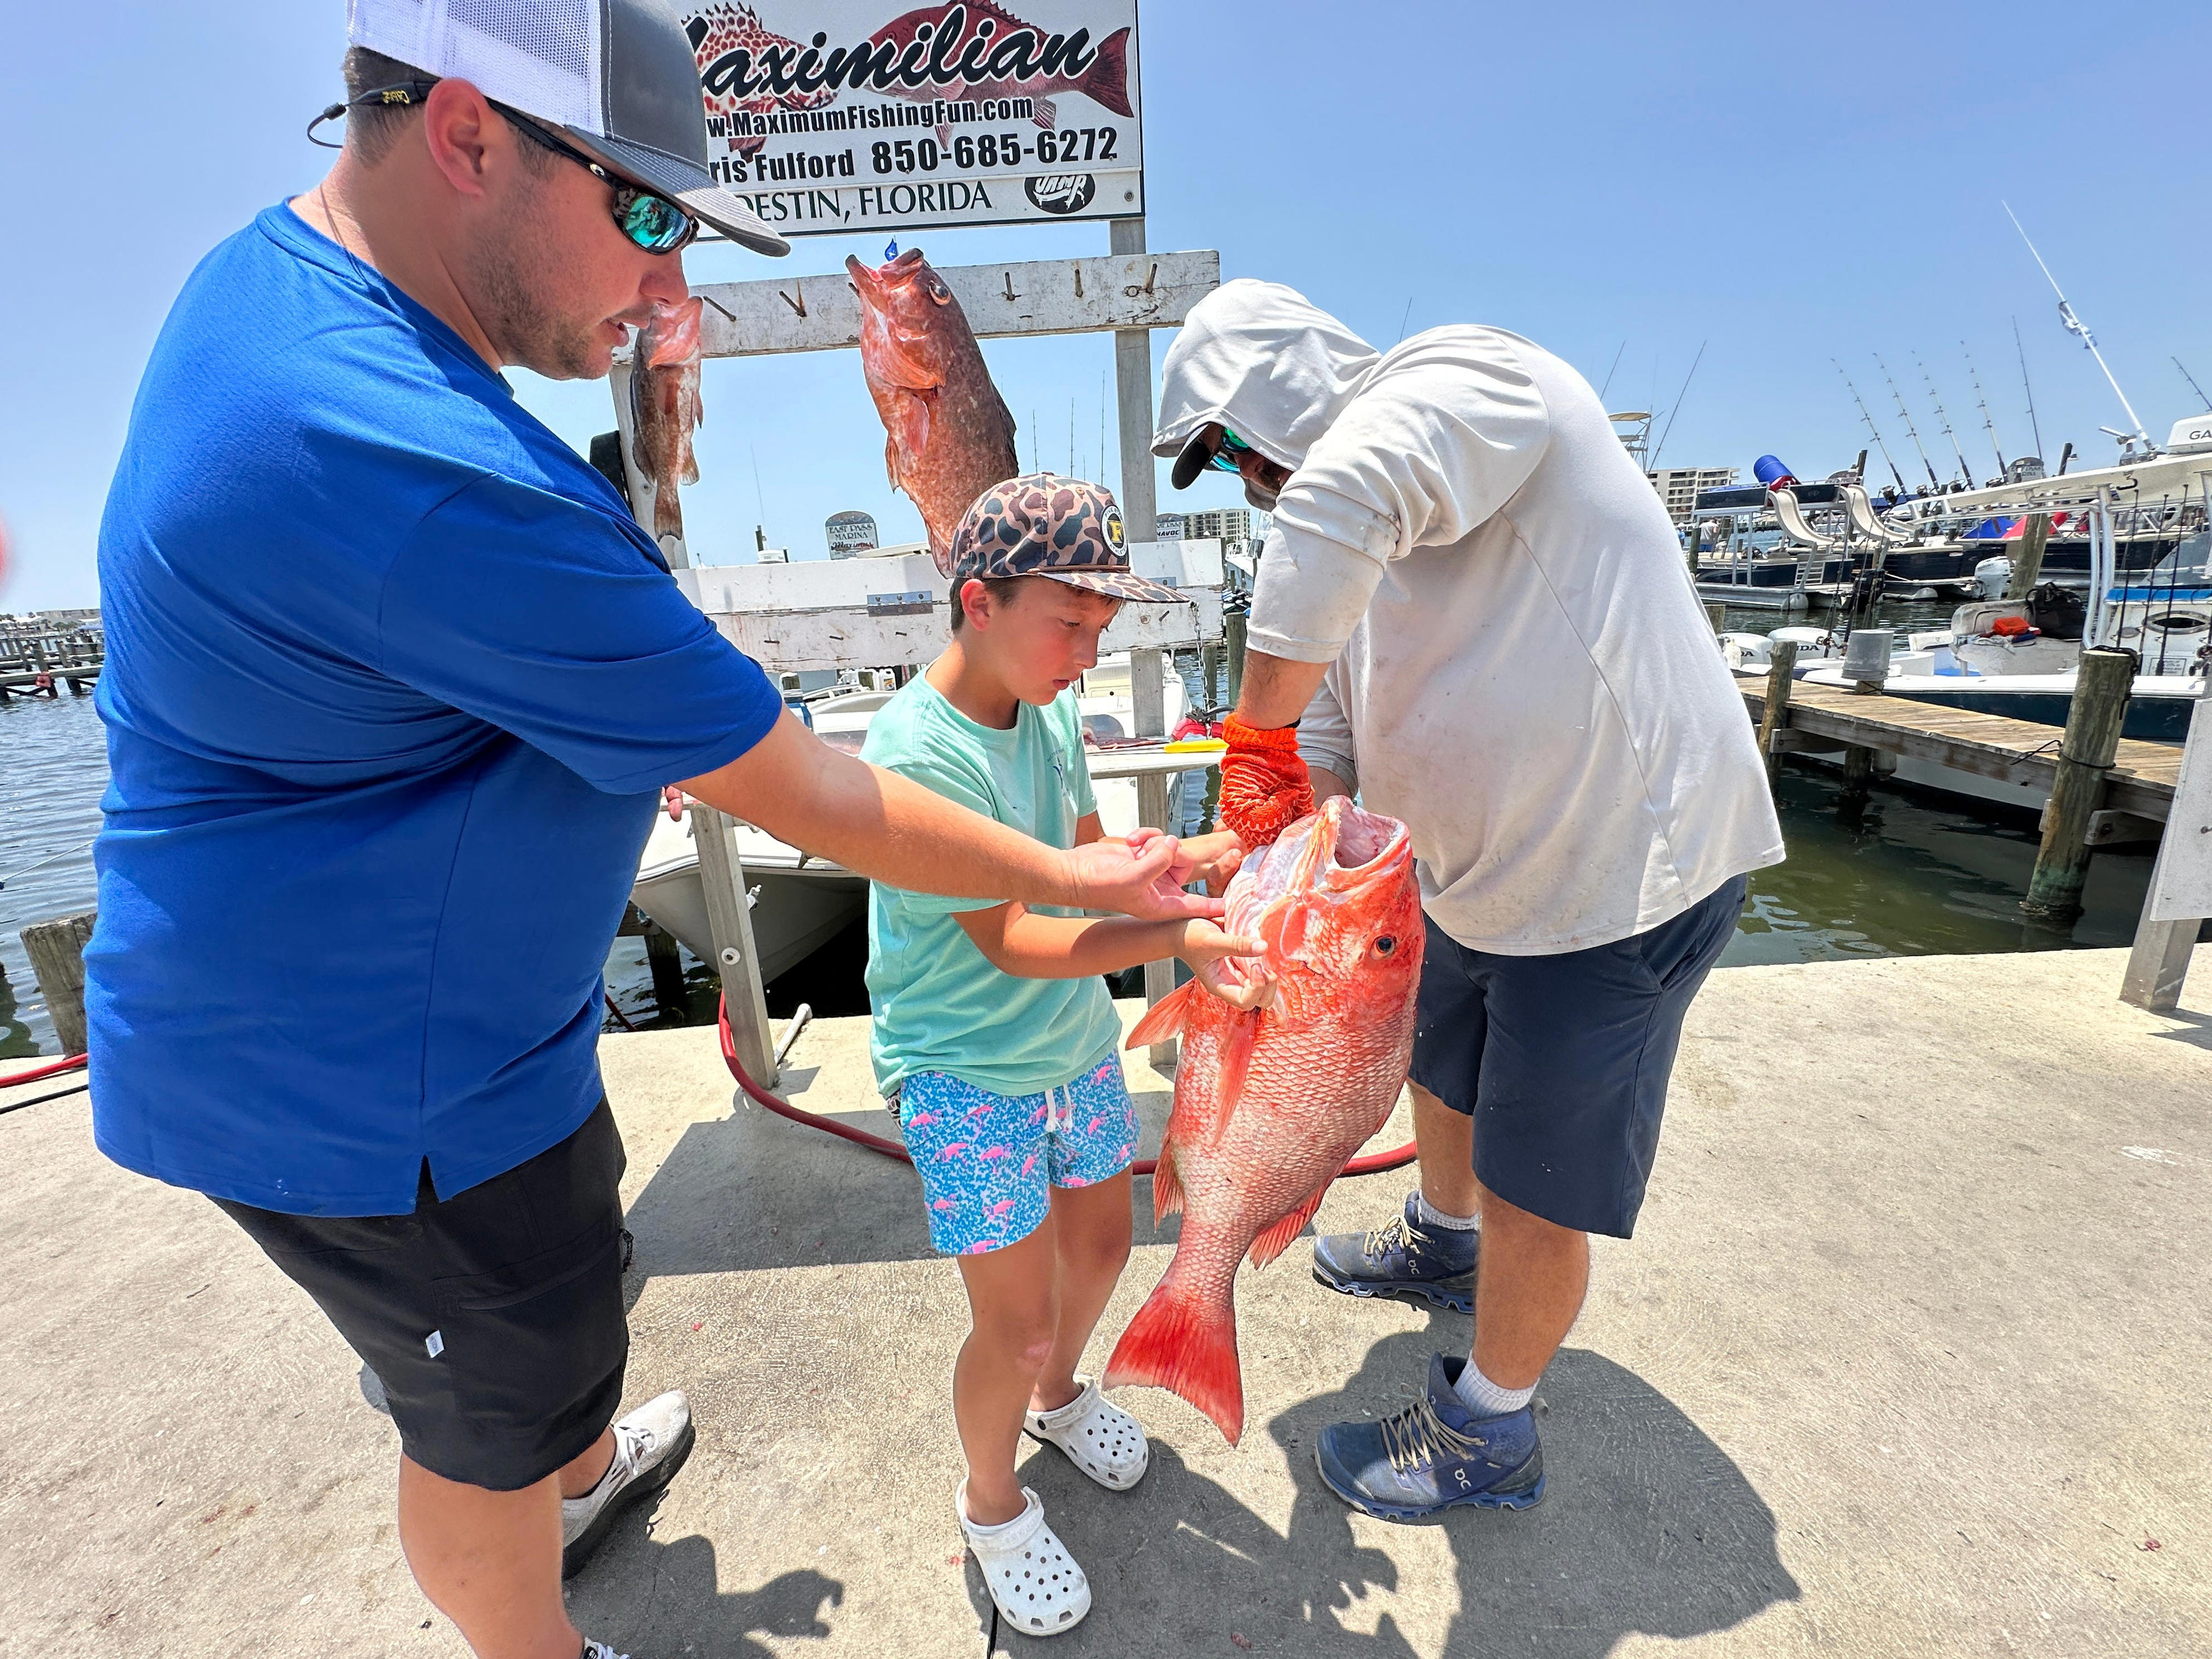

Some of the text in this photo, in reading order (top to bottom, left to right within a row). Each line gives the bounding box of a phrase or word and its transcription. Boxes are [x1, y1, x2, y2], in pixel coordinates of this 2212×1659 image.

[686, 4, 1097, 98] aximilian
[707, 98, 1033, 137] w.MaximumFishingFun.com
[709, 127, 1117, 183] ris Fulford 850-685-6272
[859, 181, 992, 215] FLORIDA
[829, 523, 873, 534] EAST PASS
[835, 532, 868, 540] MARINA
